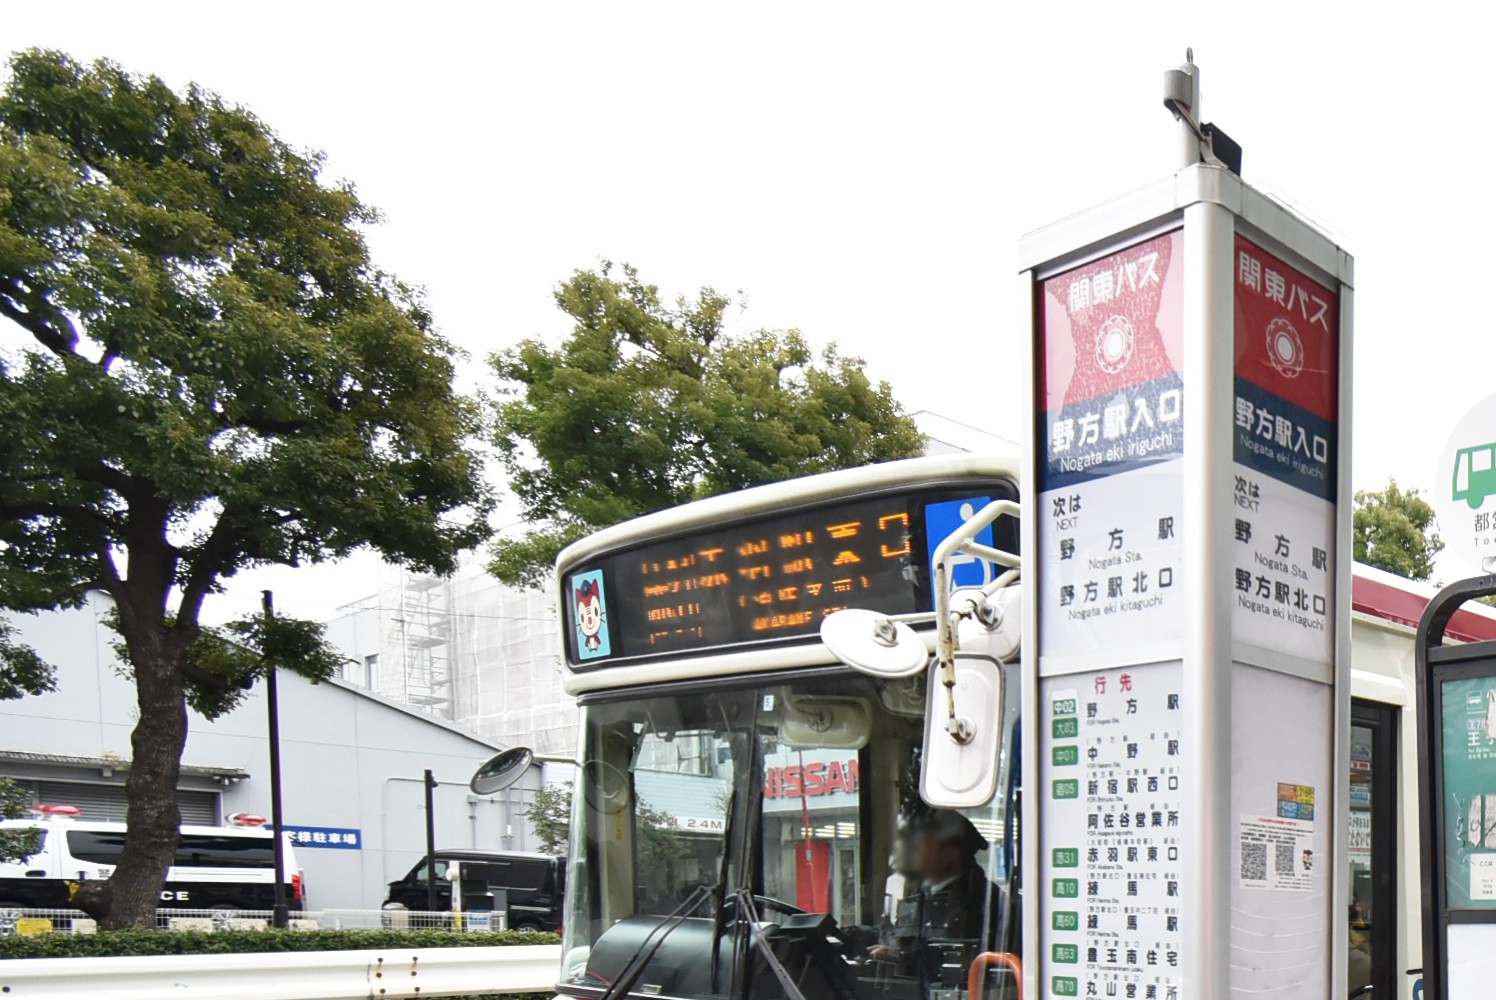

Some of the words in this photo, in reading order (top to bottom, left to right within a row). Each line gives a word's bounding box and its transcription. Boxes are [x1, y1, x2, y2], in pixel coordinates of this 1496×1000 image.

[1070, 252, 1160, 313] 関東バス
[1239, 251, 1329, 332] 関東バス
[1053, 389, 1180, 452] 野方駅入口
[1236, 397, 1328, 464] 野方駅入口
[1061, 453, 1102, 474] Nogata
[1107, 445, 1124, 462] eki
[1128, 430, 1173, 456] iriguchi
[1240, 434, 1274, 460] Nogata
[1276, 451, 1290, 465] eki
[1292, 455, 1324, 480] iriguchi
[1234, 475, 1260, 498] 次は
[1053, 493, 1081, 517] 次は
[1234, 494, 1260, 514] NEXT
[1056, 517, 1078, 531] NEXT
[1060, 517, 1174, 561] 野方駅
[1235, 518, 1327, 572] 野方駅
[1088, 556, 1122, 570] Nogata
[1125, 551, 1142, 563] Sta.
[1254, 551, 1289, 573] Nogata
[1291, 565, 1309, 581] Sta.
[1060, 567, 1172, 607] 野方駅北口
[1235, 568, 1326, 615] 野方駅北口
[1068, 606, 1100, 621] Nogata
[1103, 603, 1117, 615] eki
[1120, 593, 1163, 611] kitaguchi
[1238, 595, 1270, 615] Nogata
[1272, 606, 1285, 619] eki
[1287, 609, 1324, 631] kitaguchi
[1094, 673, 1132, 695] 行先
[1054, 700, 1074, 714] 中02
[1087, 694, 1179, 718] 野方駅
[1087, 740, 1179, 761] 中野駅
[1087, 776, 1178, 795] 新宿駅西口
[687, 818, 722, 829] 2.4M
[1087, 811, 1179, 829] 阿佐谷営業所
[1087, 847, 1178, 863] 赤羽駅東口
[1087, 881, 1178, 897] 練馬駅
[1087, 915, 1178, 931] 練馬駅
[1087, 947, 1178, 967] 豊玉南住宅
[1086, 980, 1177, 1000] 丸山営業所
